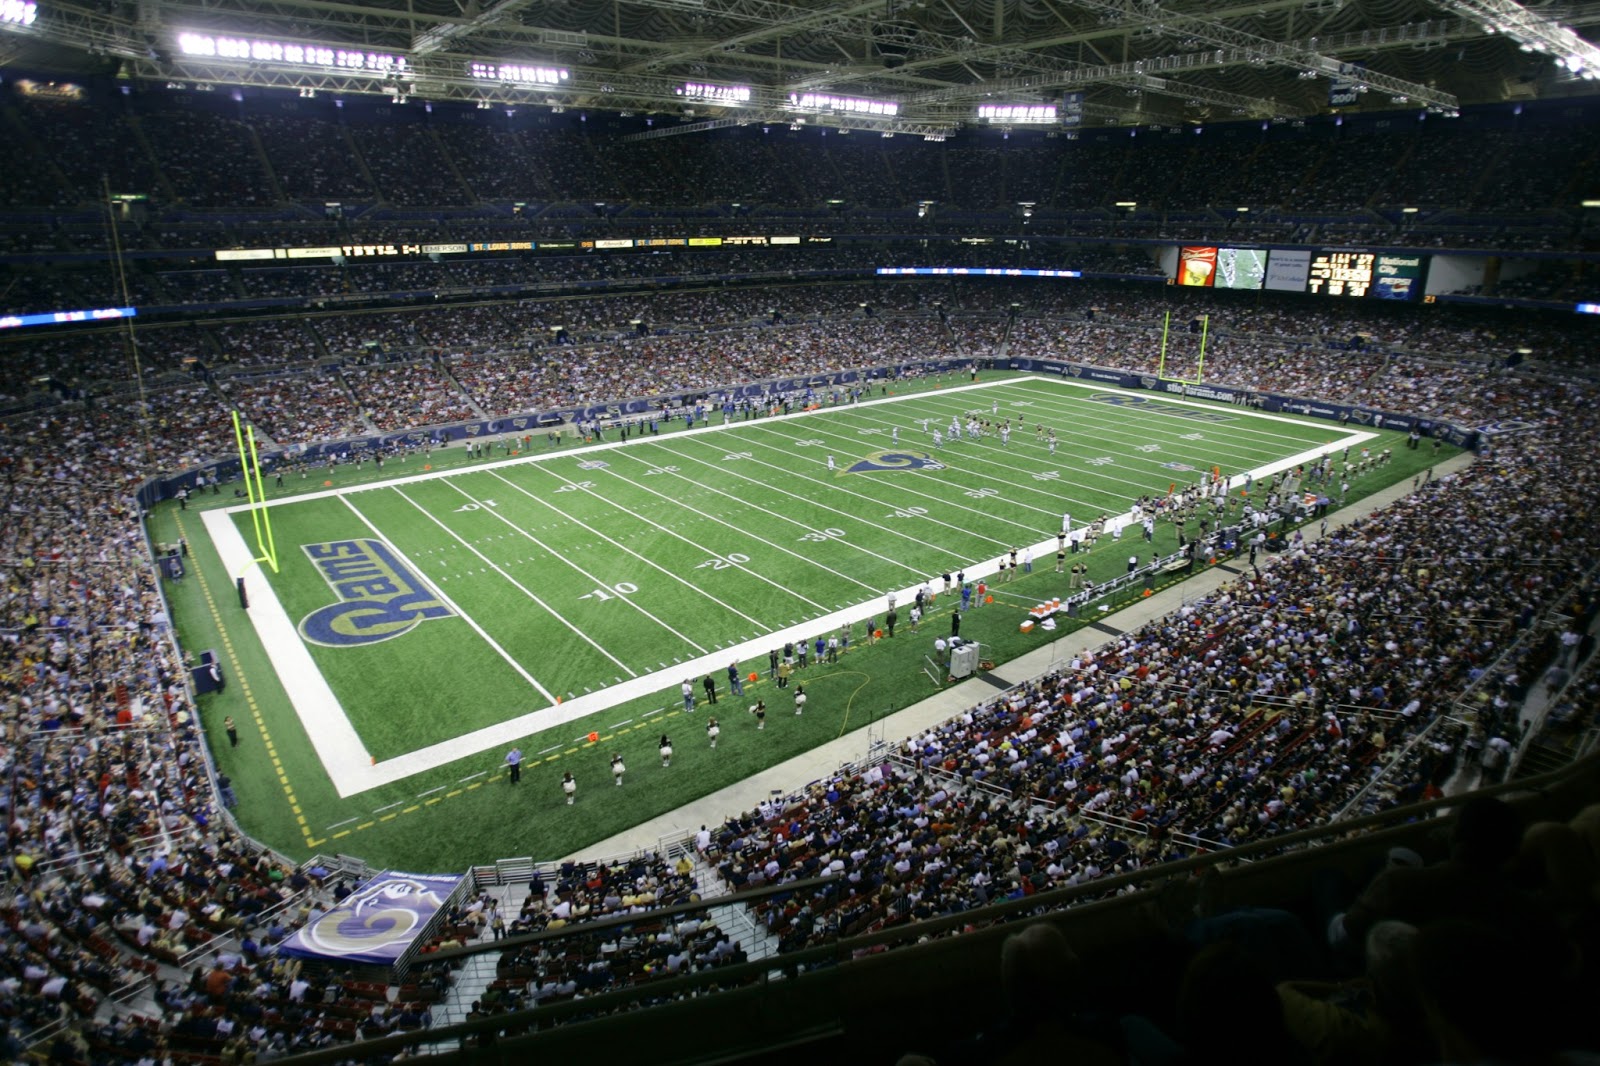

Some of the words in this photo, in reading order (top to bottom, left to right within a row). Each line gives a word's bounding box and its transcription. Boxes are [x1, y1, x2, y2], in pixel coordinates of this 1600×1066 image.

[1331, 93, 1357, 104] 2001
[424, 244, 466, 252] EMERSON
[488, 243, 510, 251] LOUIS
[511, 242, 532, 250] RAMS
[1379, 257, 1419, 267] National
[1321, 269, 1331, 278] 3
[1379, 266, 1398, 275] City
[1379, 277, 1412, 286] PEPSI
[1311, 284, 1319, 293] 1
[1328, 285, 1343, 295] 10
[1350, 287, 1366, 296] 31
[1424, 295, 1435, 303] 21
[1167, 382, 1233, 401] stloisrams.com
[559, 480, 597, 492] 20
[462, 499, 499, 511] 10
[895, 507, 929, 518] 40
[806, 527, 846, 542] 30
[705, 553, 750, 570] 20
[592, 582, 638, 602] 10
